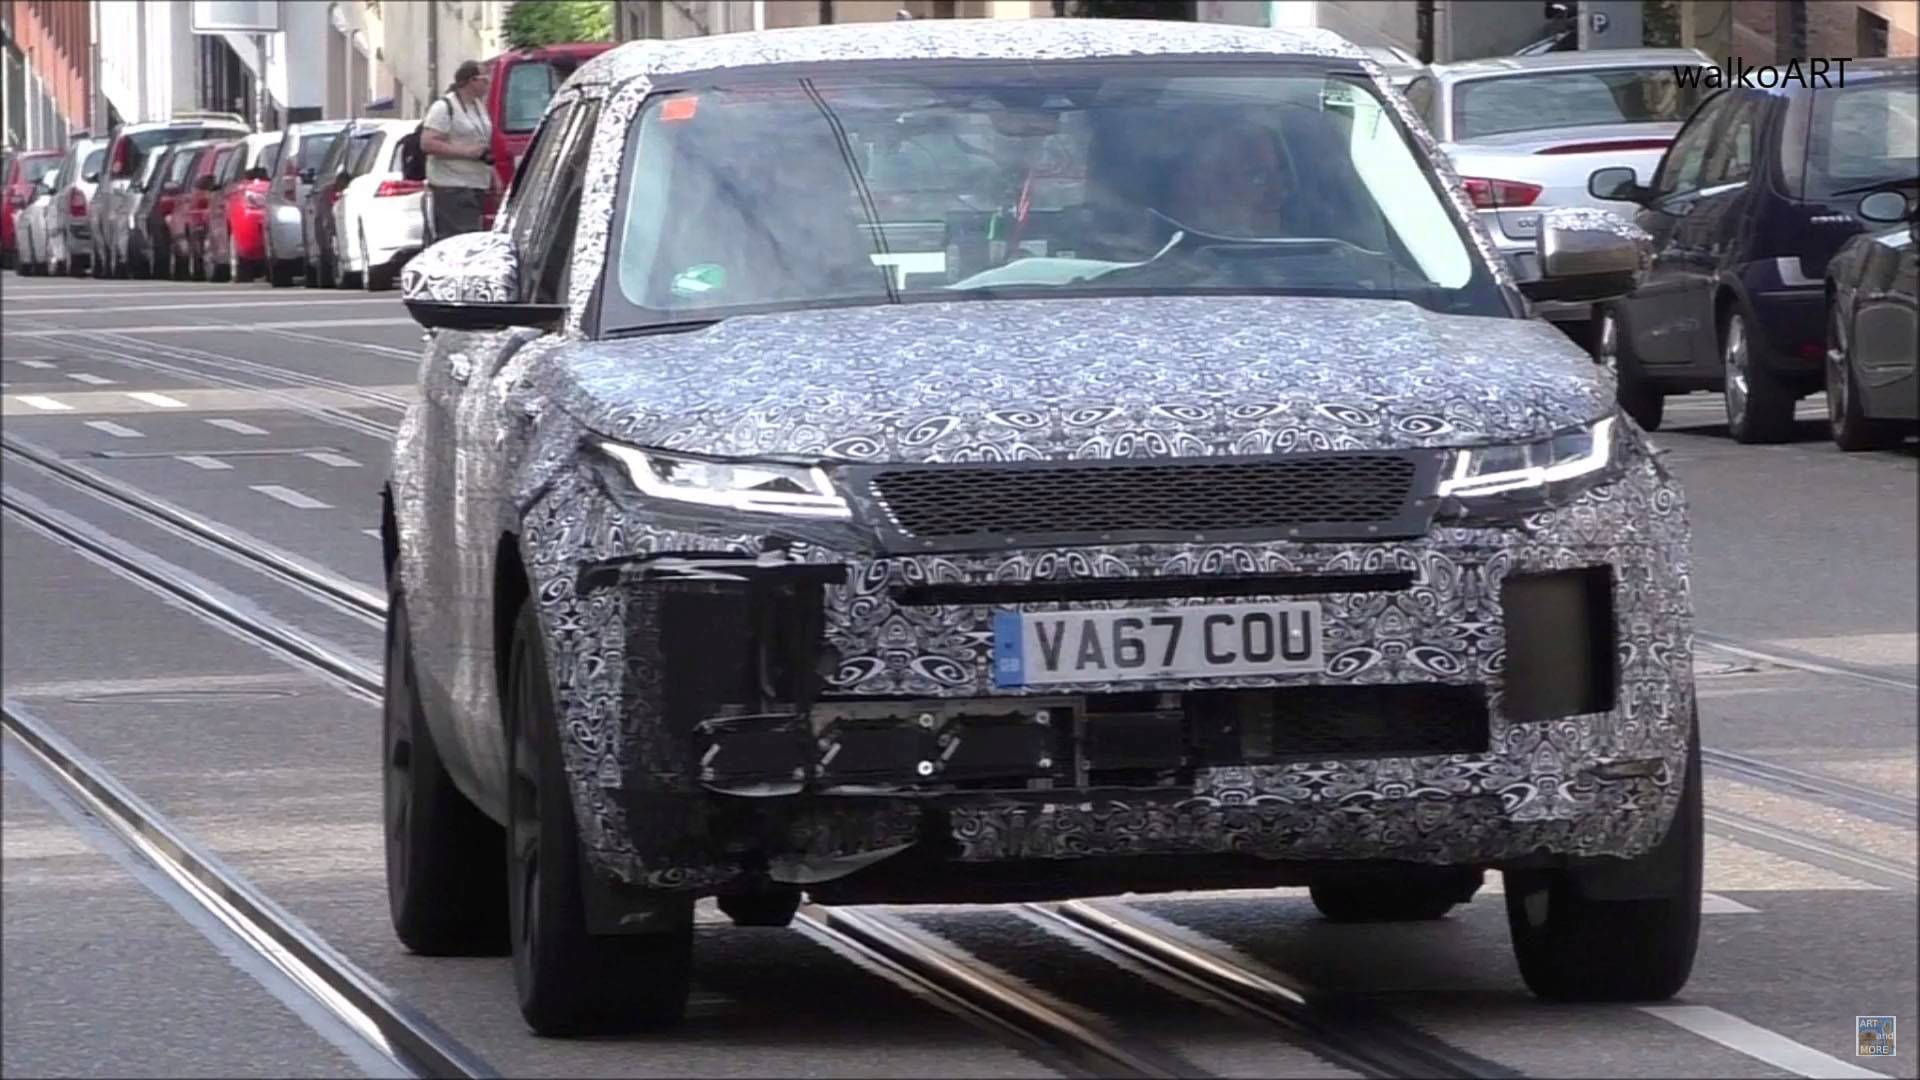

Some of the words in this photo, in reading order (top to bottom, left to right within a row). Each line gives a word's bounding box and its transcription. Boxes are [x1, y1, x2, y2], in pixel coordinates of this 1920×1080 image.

[1593, 14, 1607, 31] P
[1033, 614, 1183, 672] VA67
[1203, 610, 1312, 665] COU
